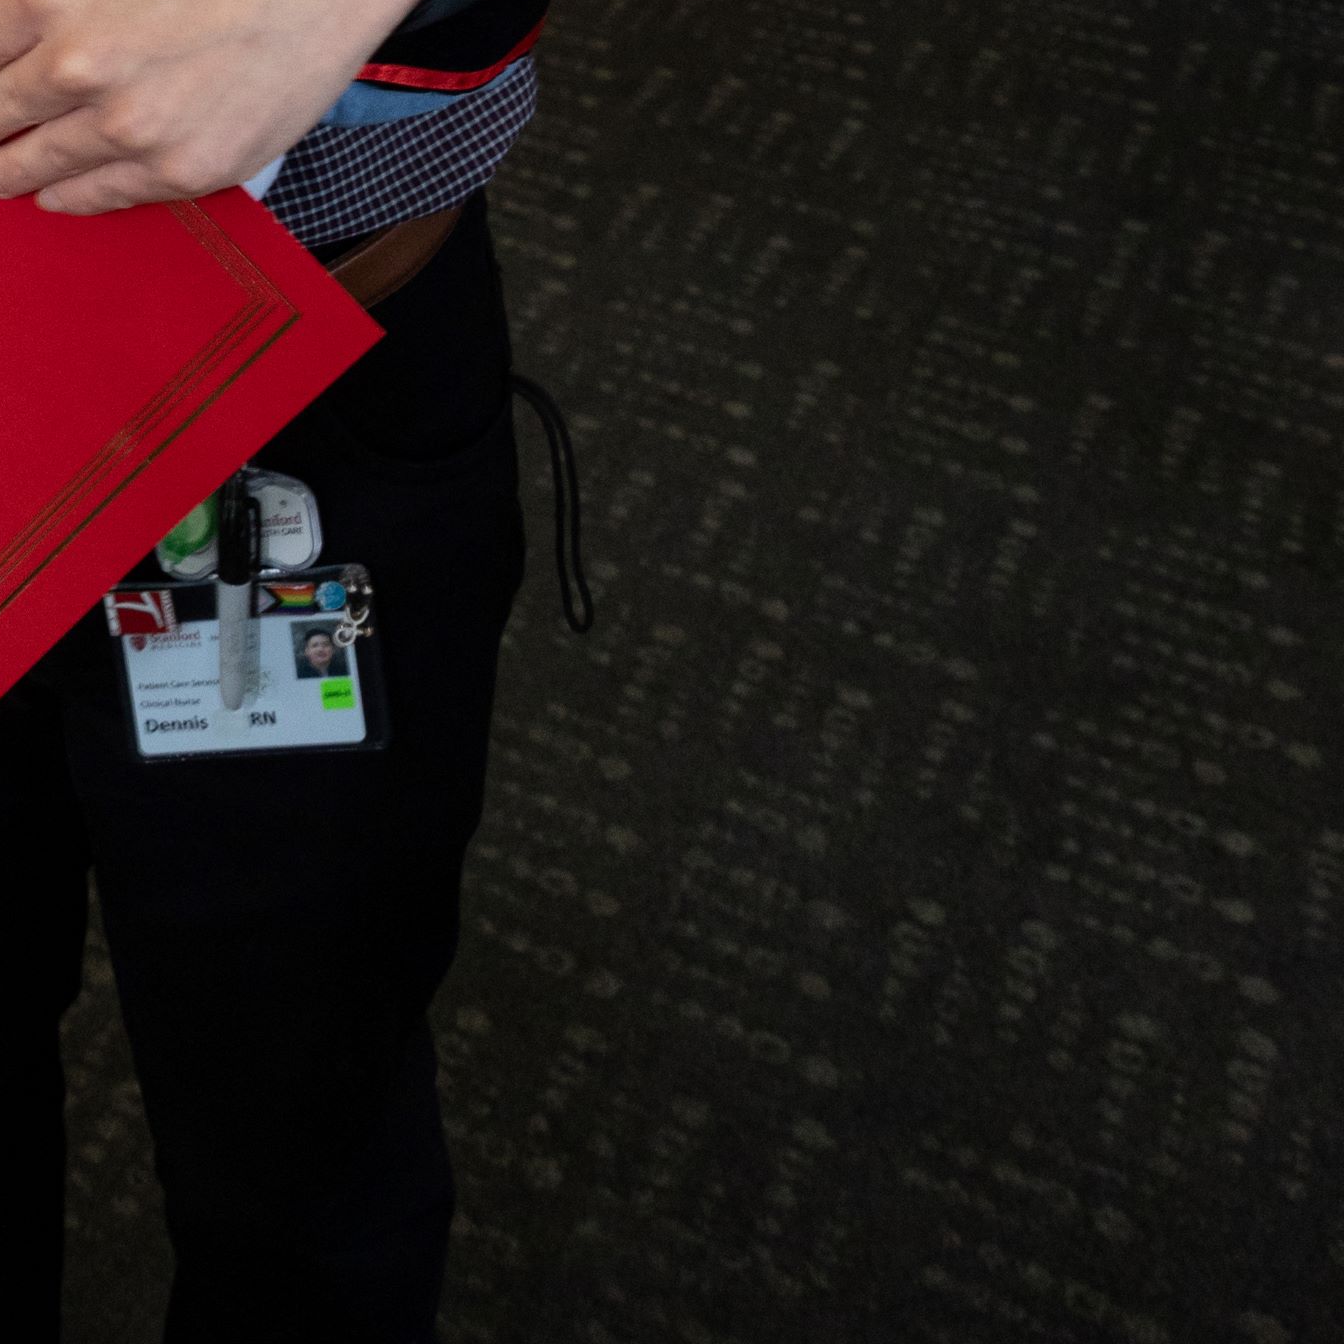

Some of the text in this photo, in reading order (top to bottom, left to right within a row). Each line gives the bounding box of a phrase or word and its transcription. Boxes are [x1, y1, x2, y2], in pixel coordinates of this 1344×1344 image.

[281, 526, 304, 536] CARE
[174, 698, 201, 706] Nurse
[145, 711, 276, 733] Dennis RN
